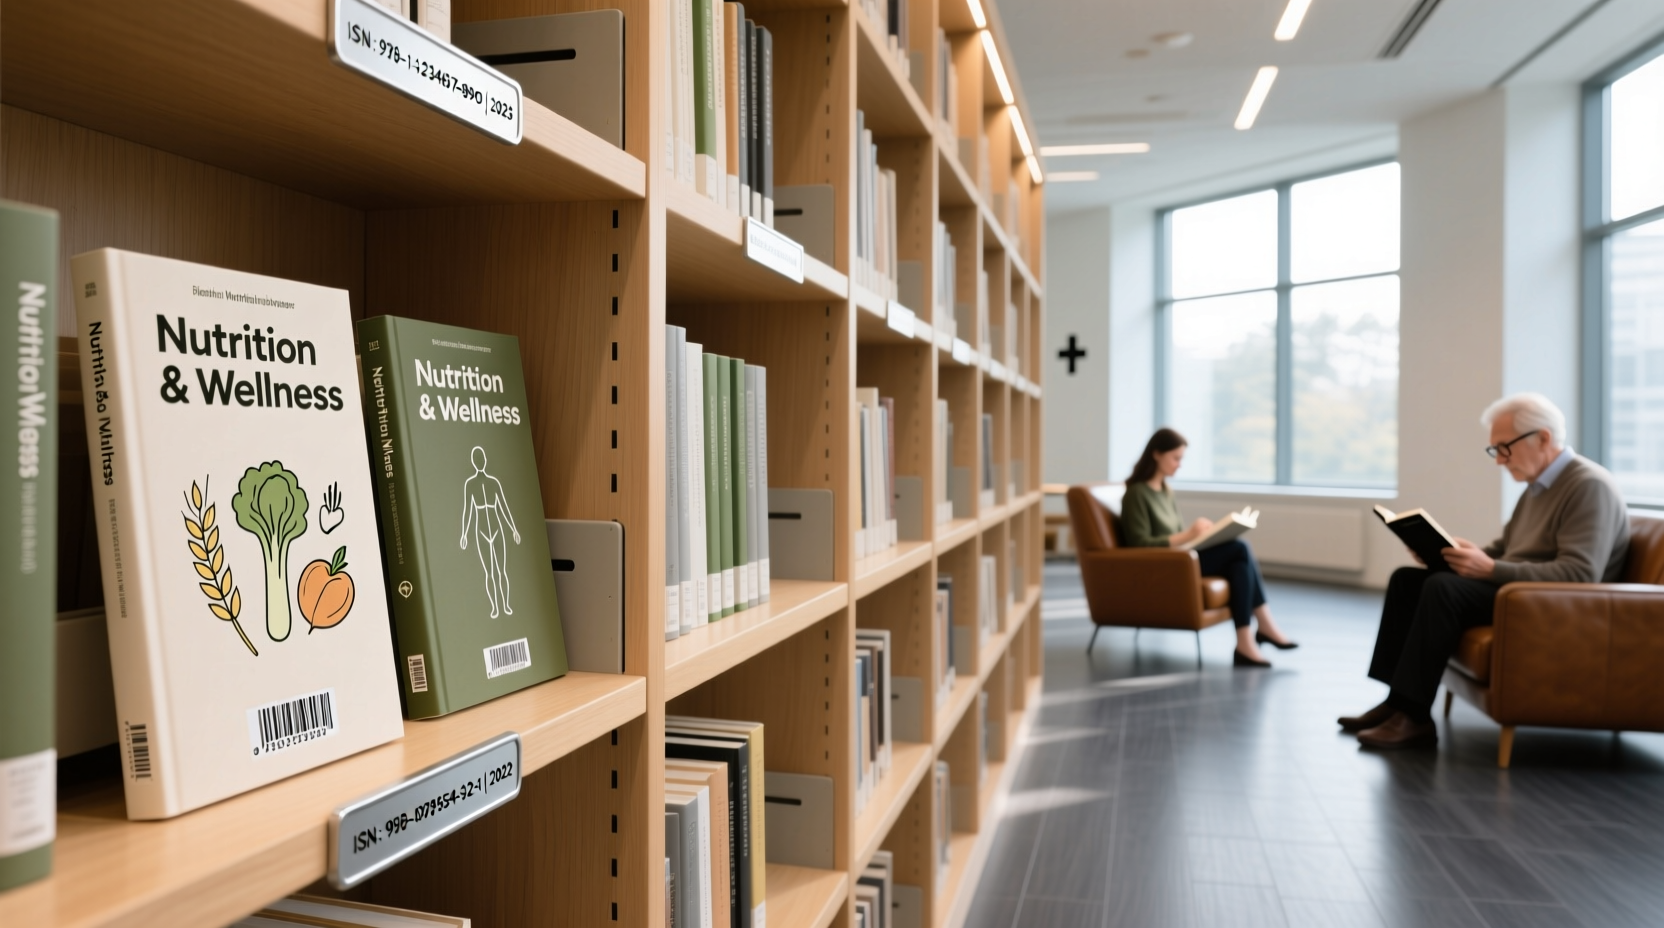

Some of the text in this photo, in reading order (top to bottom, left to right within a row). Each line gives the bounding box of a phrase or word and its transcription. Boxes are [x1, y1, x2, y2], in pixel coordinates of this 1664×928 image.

[156, 313, 317, 366] Nutrition
[160, 365, 344, 412] & Wellness
[414, 358, 504, 393] Nutrition
[419, 393, 521, 426] & Wellness
[353, 826, 382, 854] ISN:
[489, 761, 513, 786] 2022
